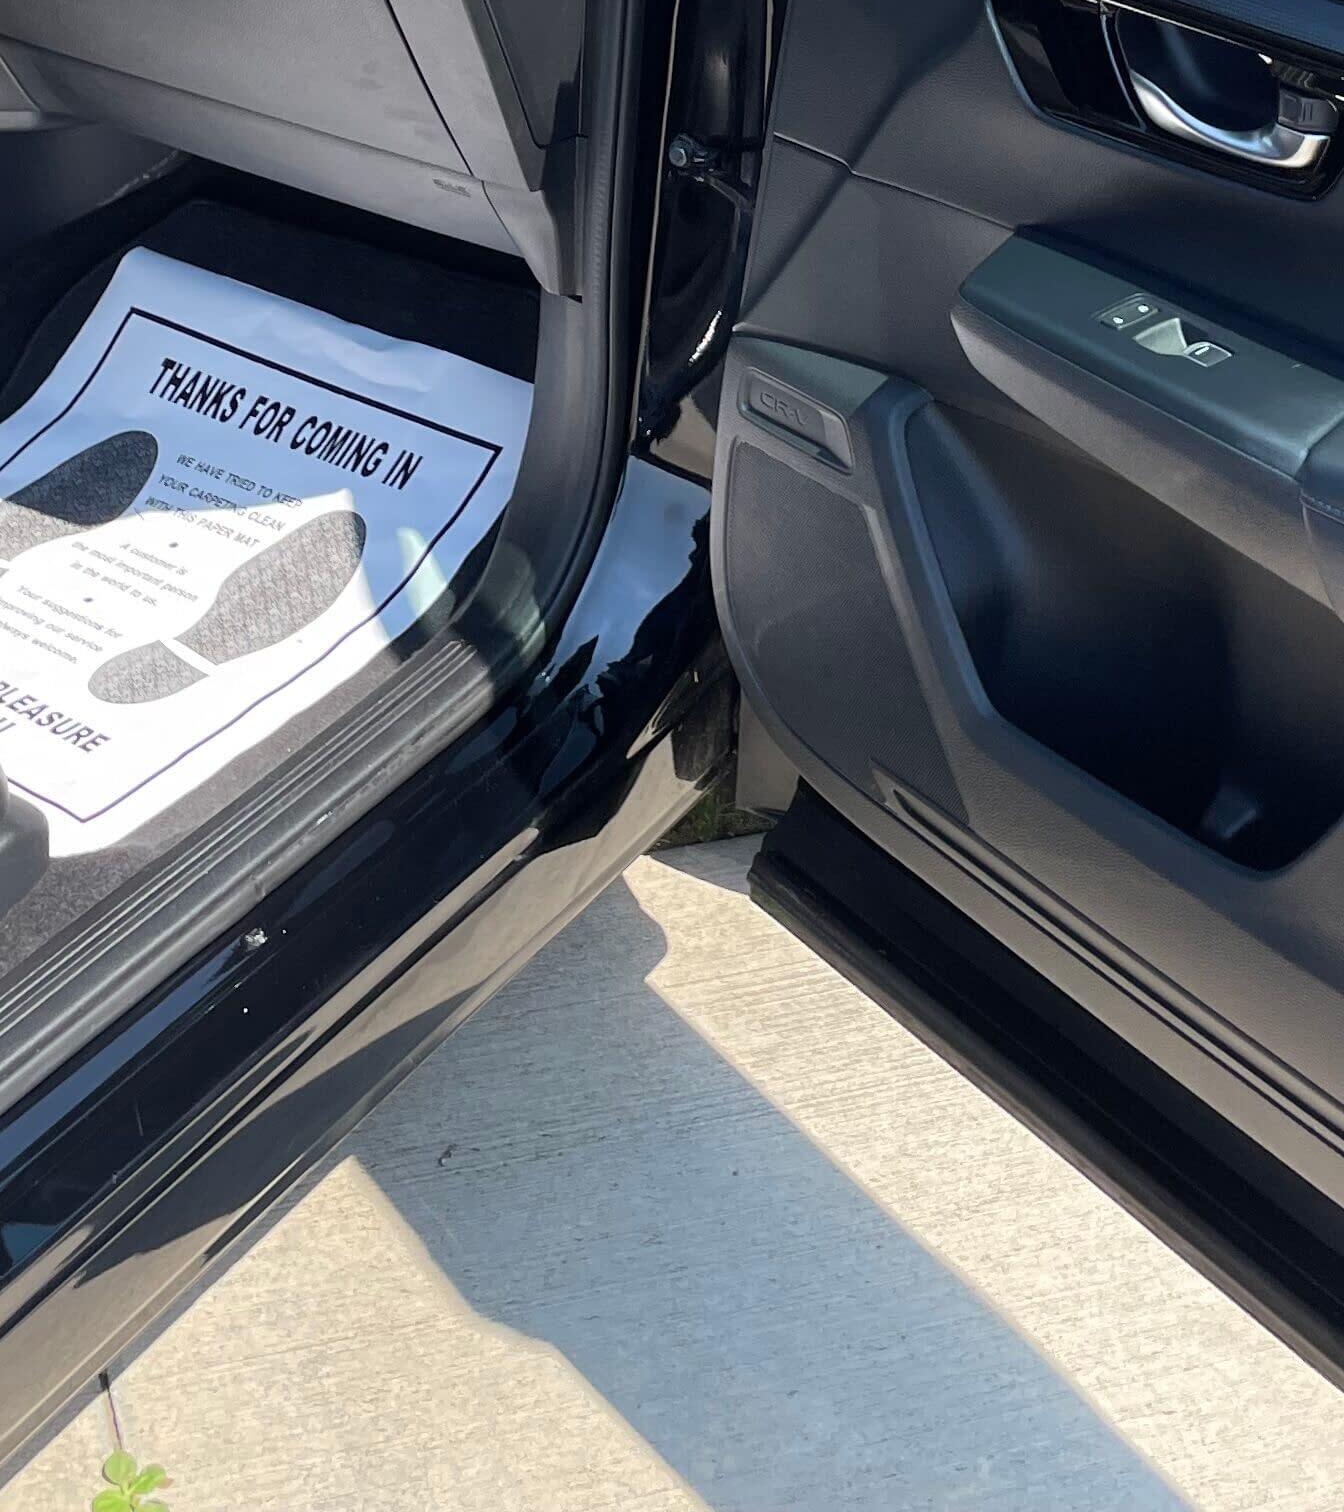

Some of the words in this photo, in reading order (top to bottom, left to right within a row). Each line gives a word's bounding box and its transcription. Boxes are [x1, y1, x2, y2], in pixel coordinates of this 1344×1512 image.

[149, 357, 247, 423] THANKS
[238, 395, 297, 443] FOR
[289, 415, 390, 478] COMING
[381, 448, 424, 490] IN
[158, 473, 189, 493] YOUR
[188, 487, 249, 516] CARPETING
[248, 511, 286, 531] CLEAN
[176, 454, 196, 468] WE
[194, 461, 225, 480] HAVE
[224, 472, 257, 492] TRIED
[256, 485, 273, 498] TO
[272, 492, 304, 508] KEEP
[145, 495, 172, 511] WITH
[173, 506, 198, 523] THIS
[196, 518, 235, 538] PAPER
[233, 532, 261, 547] MAT
[82, 567, 101, 578] the
[101, 575, 132, 592] world
[130, 589, 143, 598] to
[88, 549, 117, 564] most
[115, 560, 165, 586] important
[160, 583, 199, 602] person
[130, 548, 178, 570] customer
[176, 565, 189, 575] is
[18, 585, 43, 601] Your
[41, 599, 105, 631] suggestions
[104, 627, 124, 639] for
[45, 622, 66, 634] our
[64, 632, 103, 652] service
